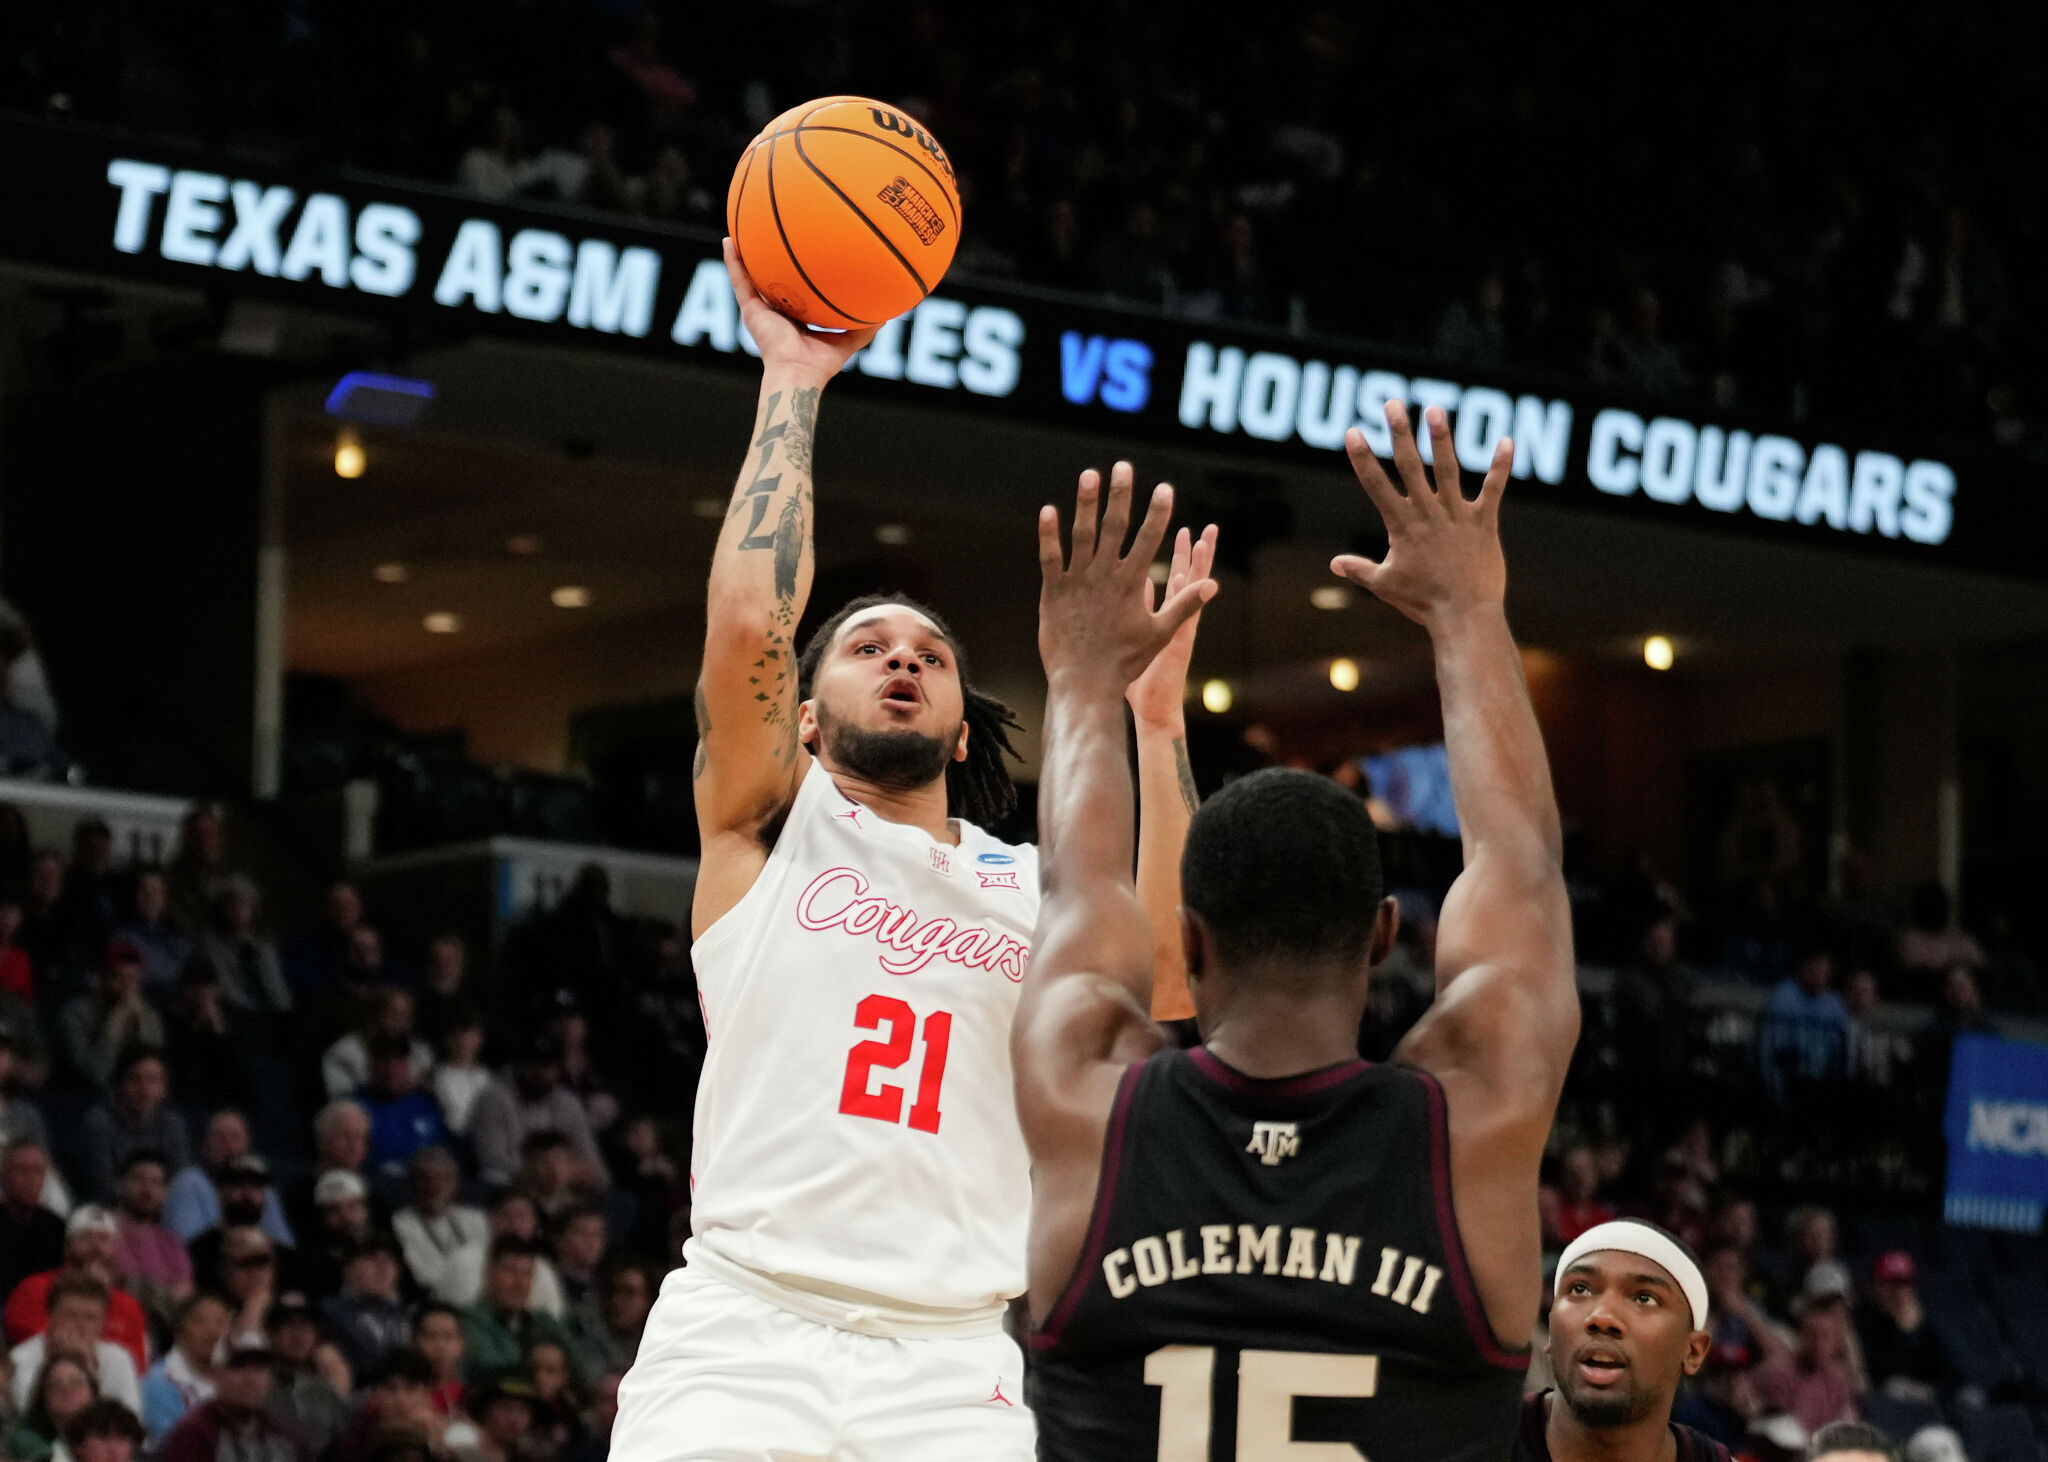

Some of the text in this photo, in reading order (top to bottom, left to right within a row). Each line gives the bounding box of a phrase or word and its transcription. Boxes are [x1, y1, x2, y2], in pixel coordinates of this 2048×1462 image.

[899, 199, 938, 243] MADNESS
[903, 185, 936, 221] MARCH
[107, 158, 1958, 547] TEXAS A&M AIES VS HOUSTON COUGARS
[797, 866, 1030, 983] Cougars
[838, 993, 953, 1135] 21
[1102, 1224, 1443, 1315] COLEMAN III
[1143, 1344, 1378, 1462] 15
